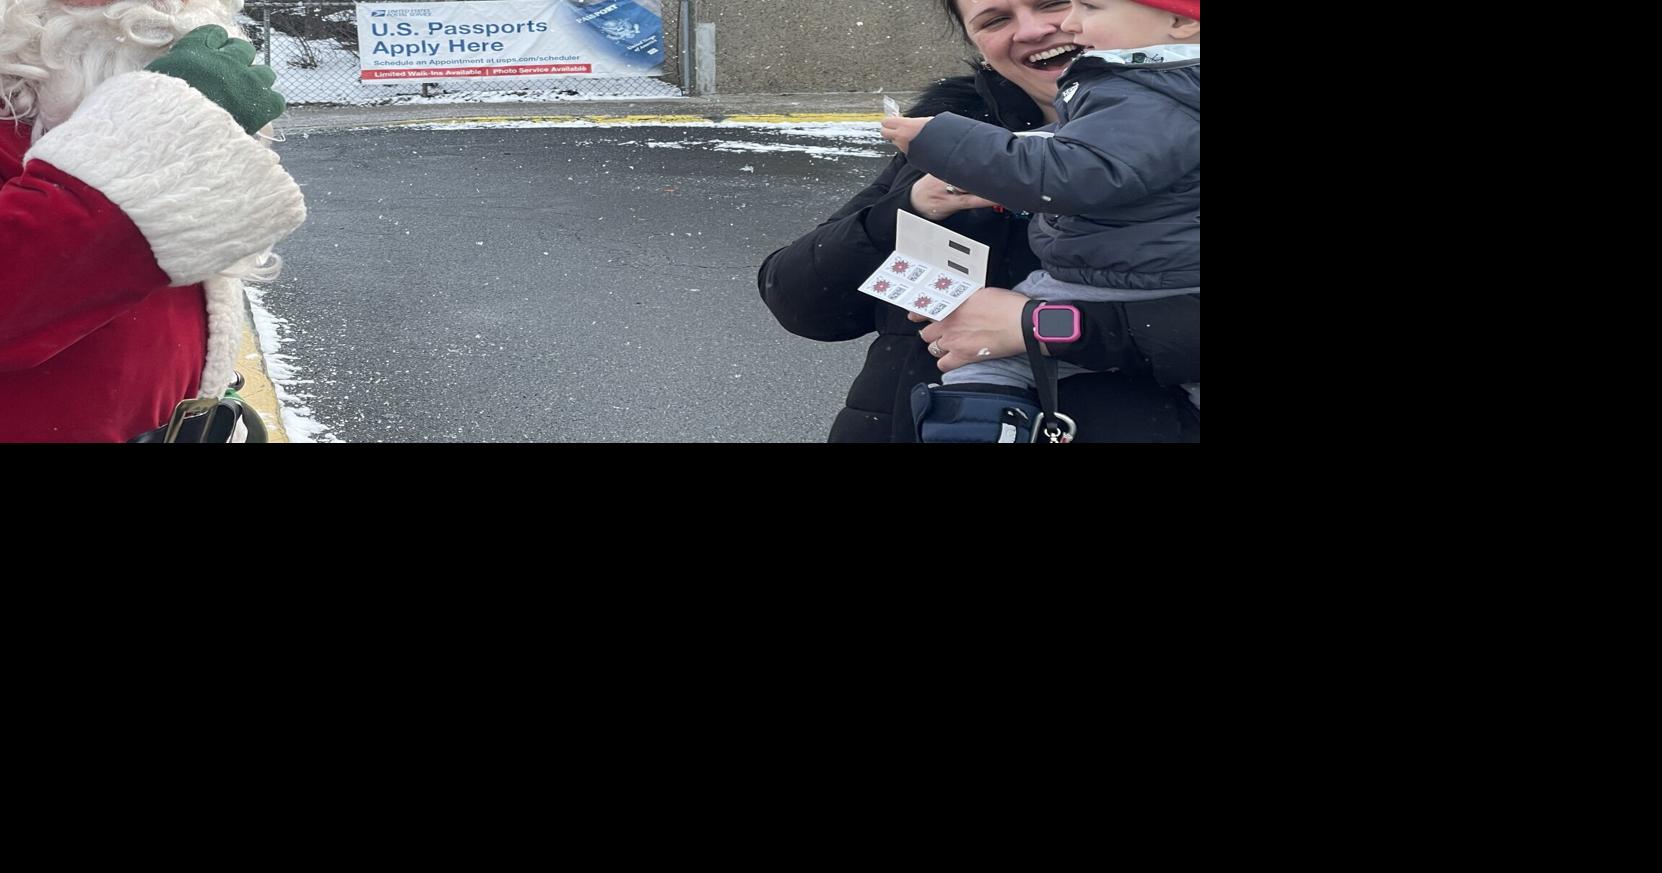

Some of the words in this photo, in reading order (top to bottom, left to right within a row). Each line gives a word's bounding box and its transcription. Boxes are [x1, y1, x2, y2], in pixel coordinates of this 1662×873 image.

[372, 22, 419, 36] U.S.
[428, 20, 547, 37] Passports
[373, 40, 440, 57] Apply
[449, 39, 504, 53] Here
[430, 58, 484, 66] Appointment
[496, 55, 580, 64] usps.com/scheduler
